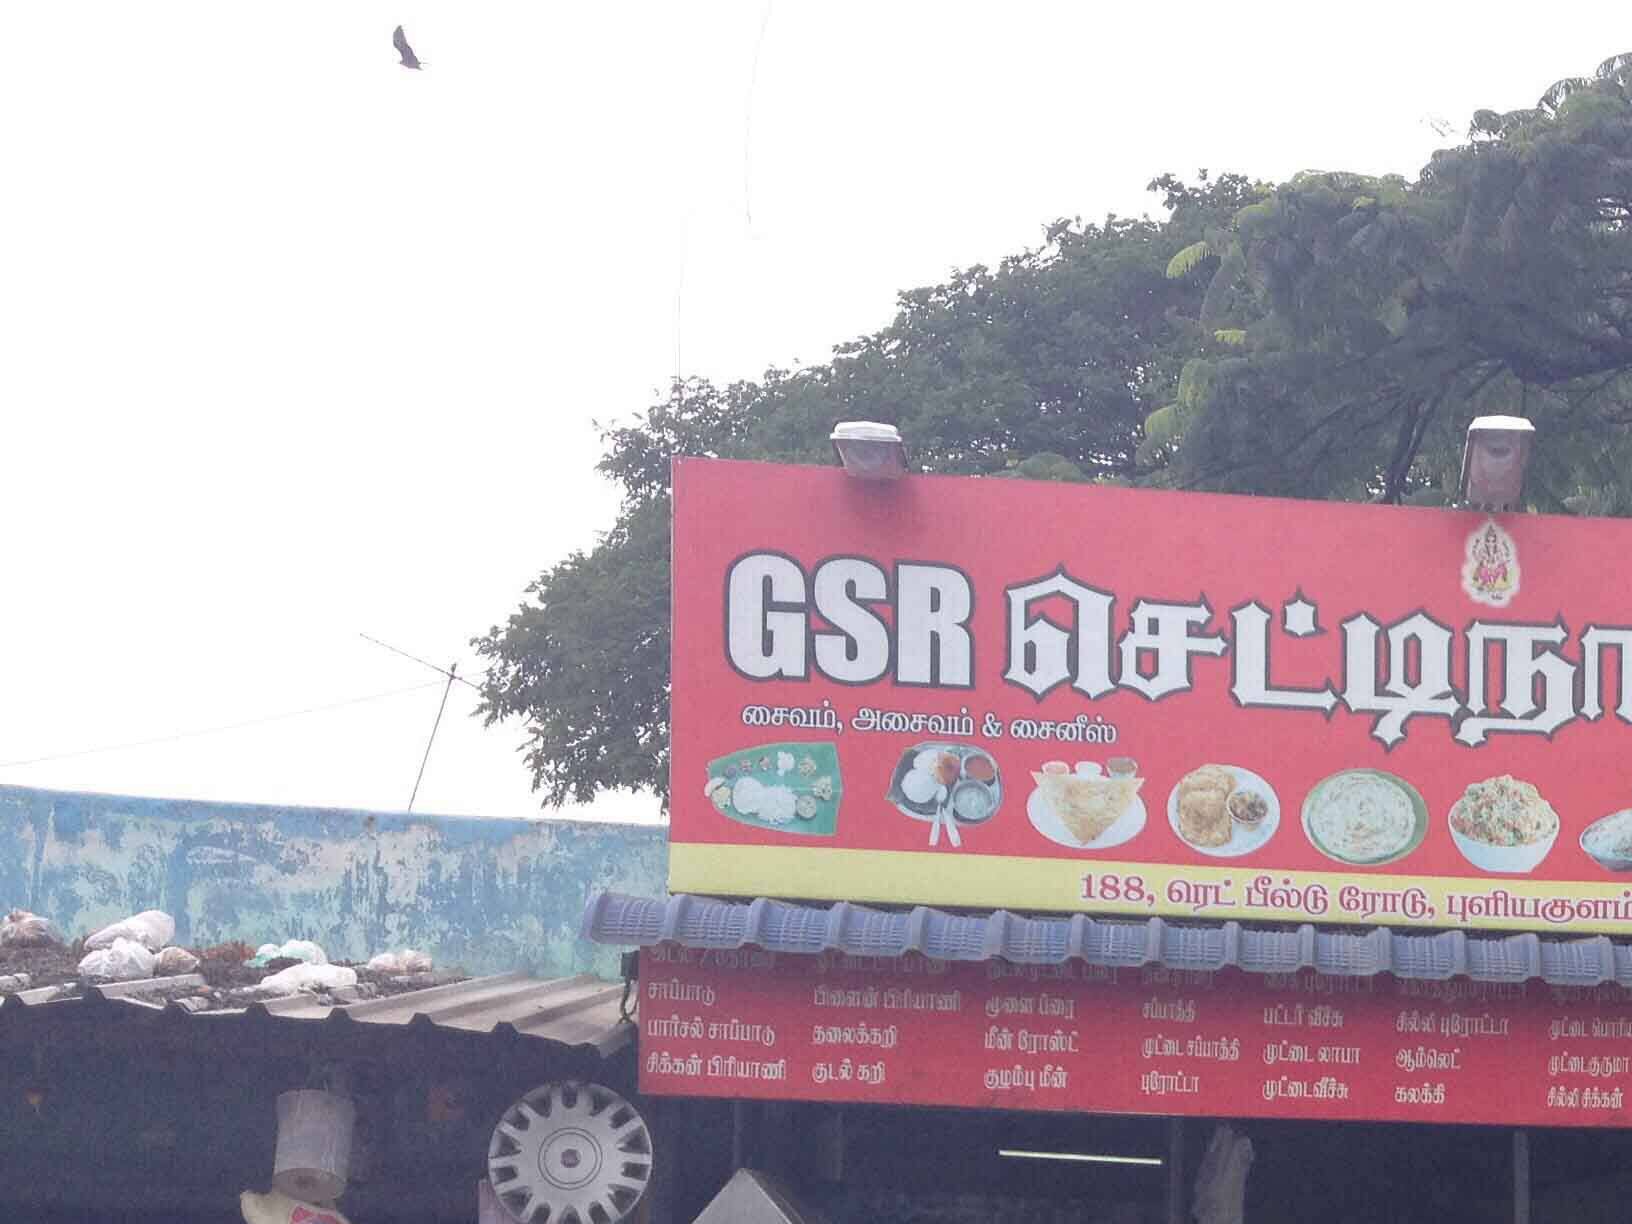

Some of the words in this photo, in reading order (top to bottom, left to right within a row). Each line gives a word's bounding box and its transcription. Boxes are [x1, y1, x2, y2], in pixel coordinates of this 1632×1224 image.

[724, 549, 974, 689] GSR
[742, 700, 843, 732] சைவம்,
[852, 707, 974, 737] அசைவம்
[981, 713, 1003, 738] &
[1009, 714, 1118, 744] சைனீஸ்
[1081, 873, 1156, 907] 188,
[1167, 879, 1236, 912] ரெட்
[1245, 876, 1329, 915] பீல்டு
[1339, 884, 1435, 919] ரோடு,
[647, 979, 715, 1007] சாப்பாடு
[708, 1019, 776, 1047] சாப்பாடு
[646, 1050, 703, 1075] சிக்கன்
[707, 1055, 787, 1081] பிரியாணி
[1394, 1082, 1446, 1104] கலக்கி
